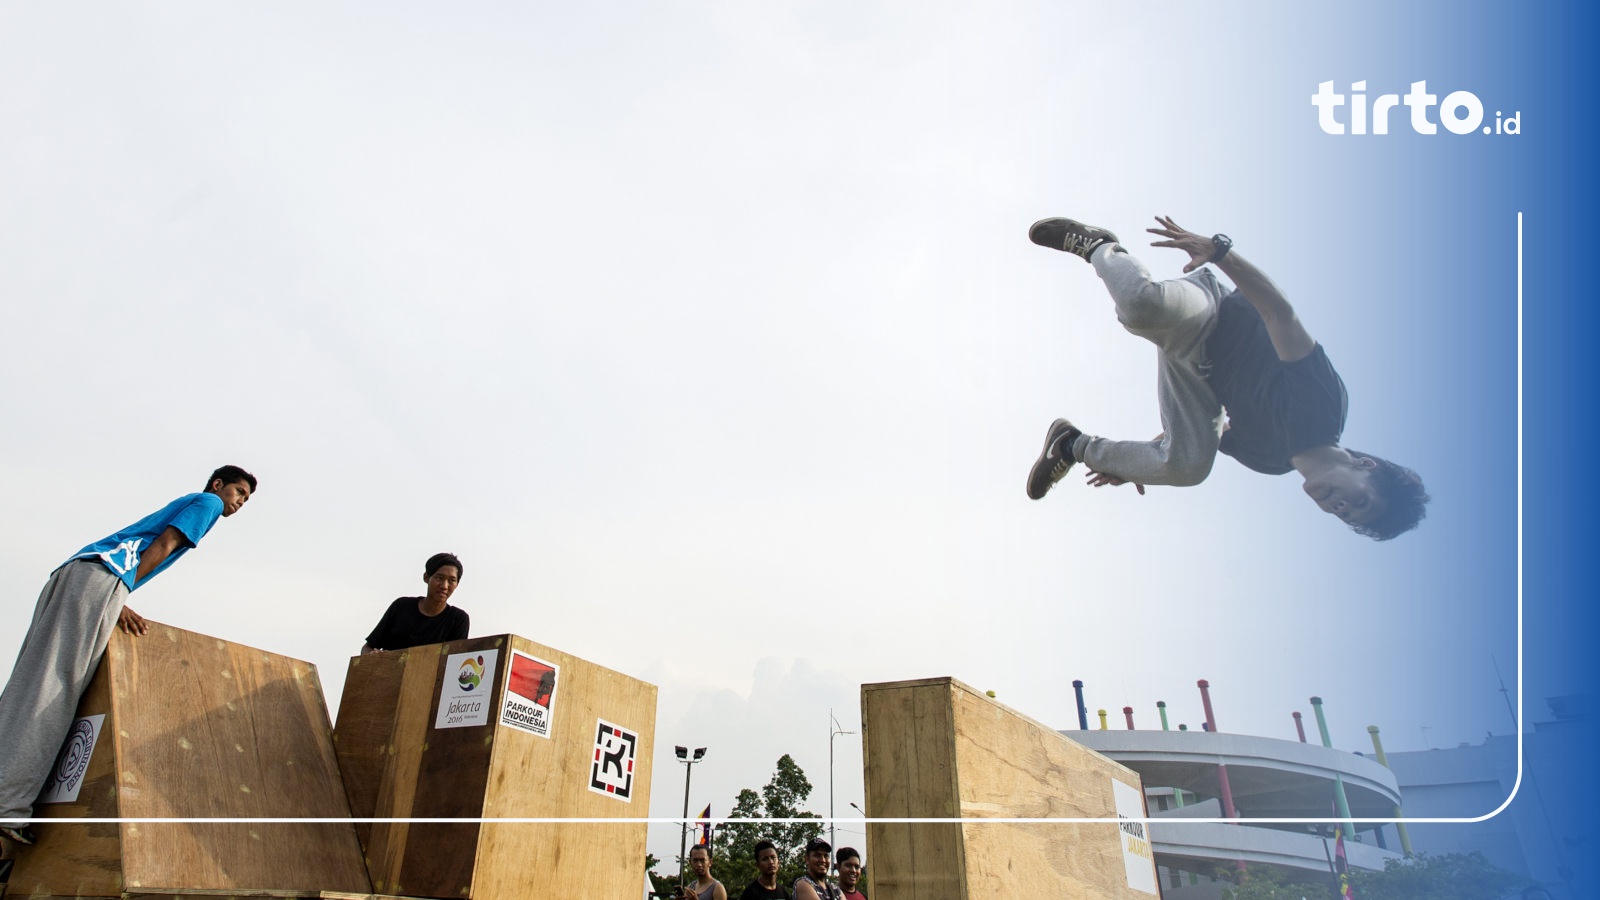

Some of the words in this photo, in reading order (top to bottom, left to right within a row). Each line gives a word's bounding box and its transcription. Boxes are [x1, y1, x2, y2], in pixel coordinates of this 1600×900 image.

[445, 700, 481, 718] Jakarta
[507, 701, 543, 718] PARKOUR
[447, 715, 463, 724] 2016
[505, 710, 546, 729] INDONESIA
